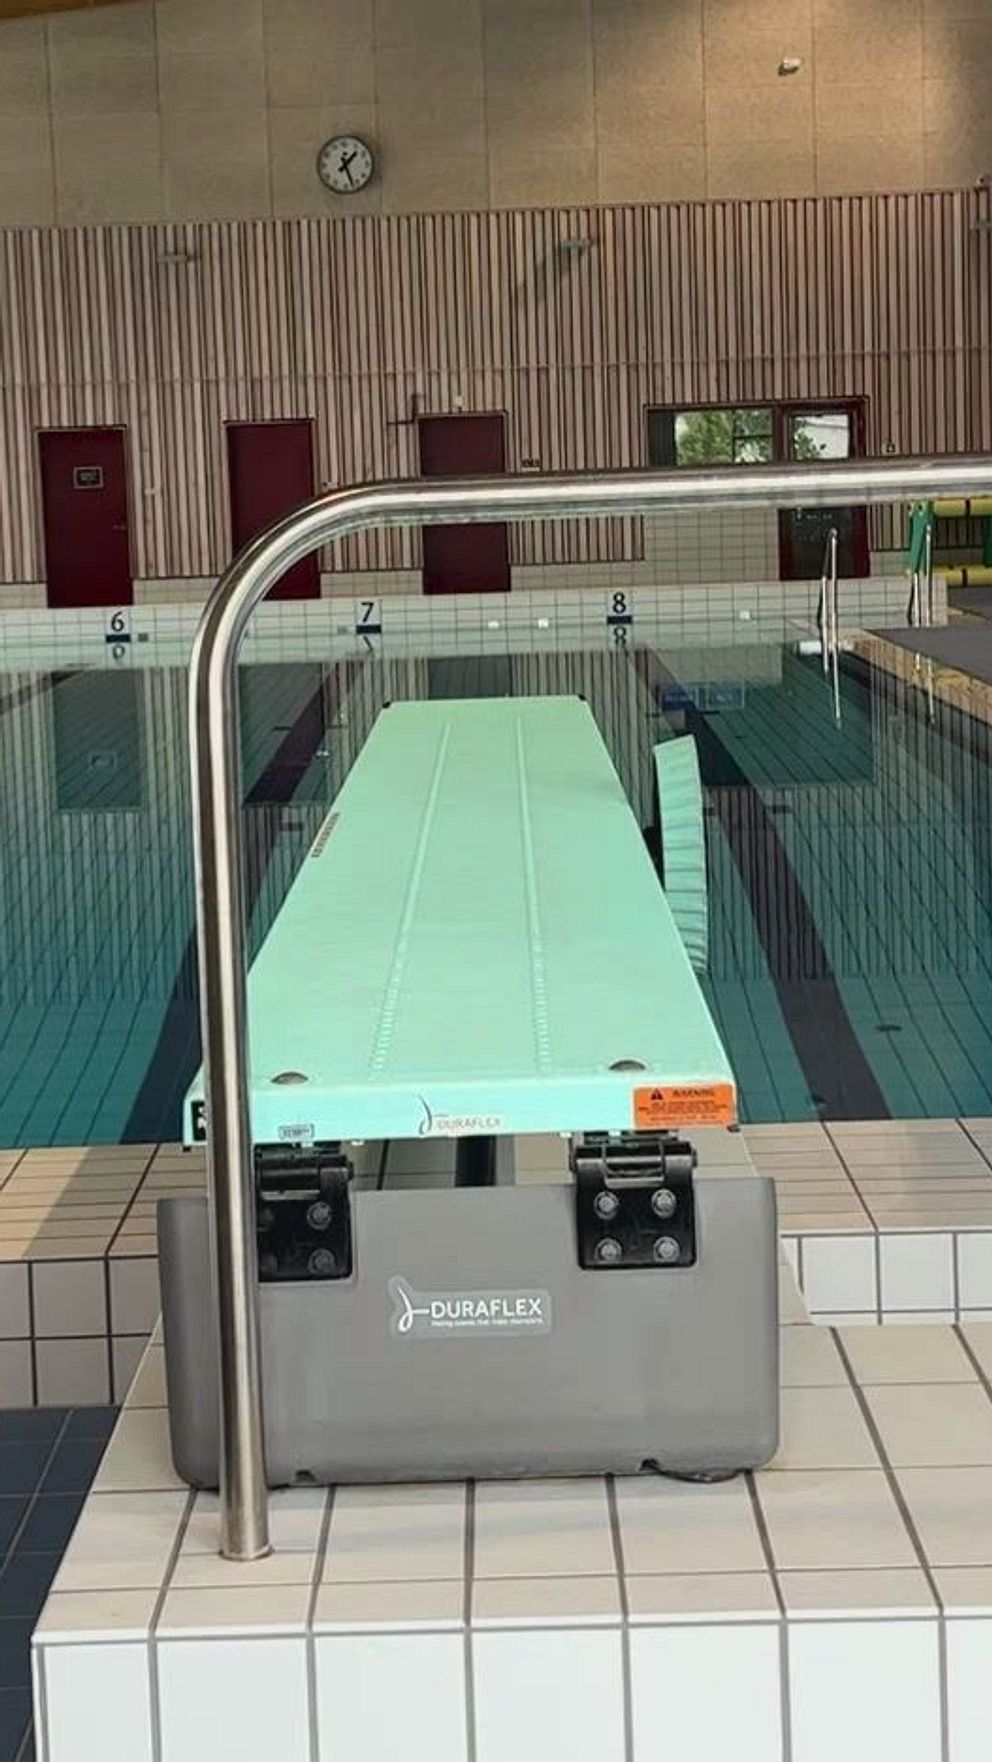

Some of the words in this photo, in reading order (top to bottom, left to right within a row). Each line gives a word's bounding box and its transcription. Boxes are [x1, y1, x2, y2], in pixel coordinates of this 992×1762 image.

[361, 602, 374, 623] 7
[613, 592, 626, 614] 8
[111, 611, 125, 632] 6
[430, 1298, 543, 1319] DURAFLEX
